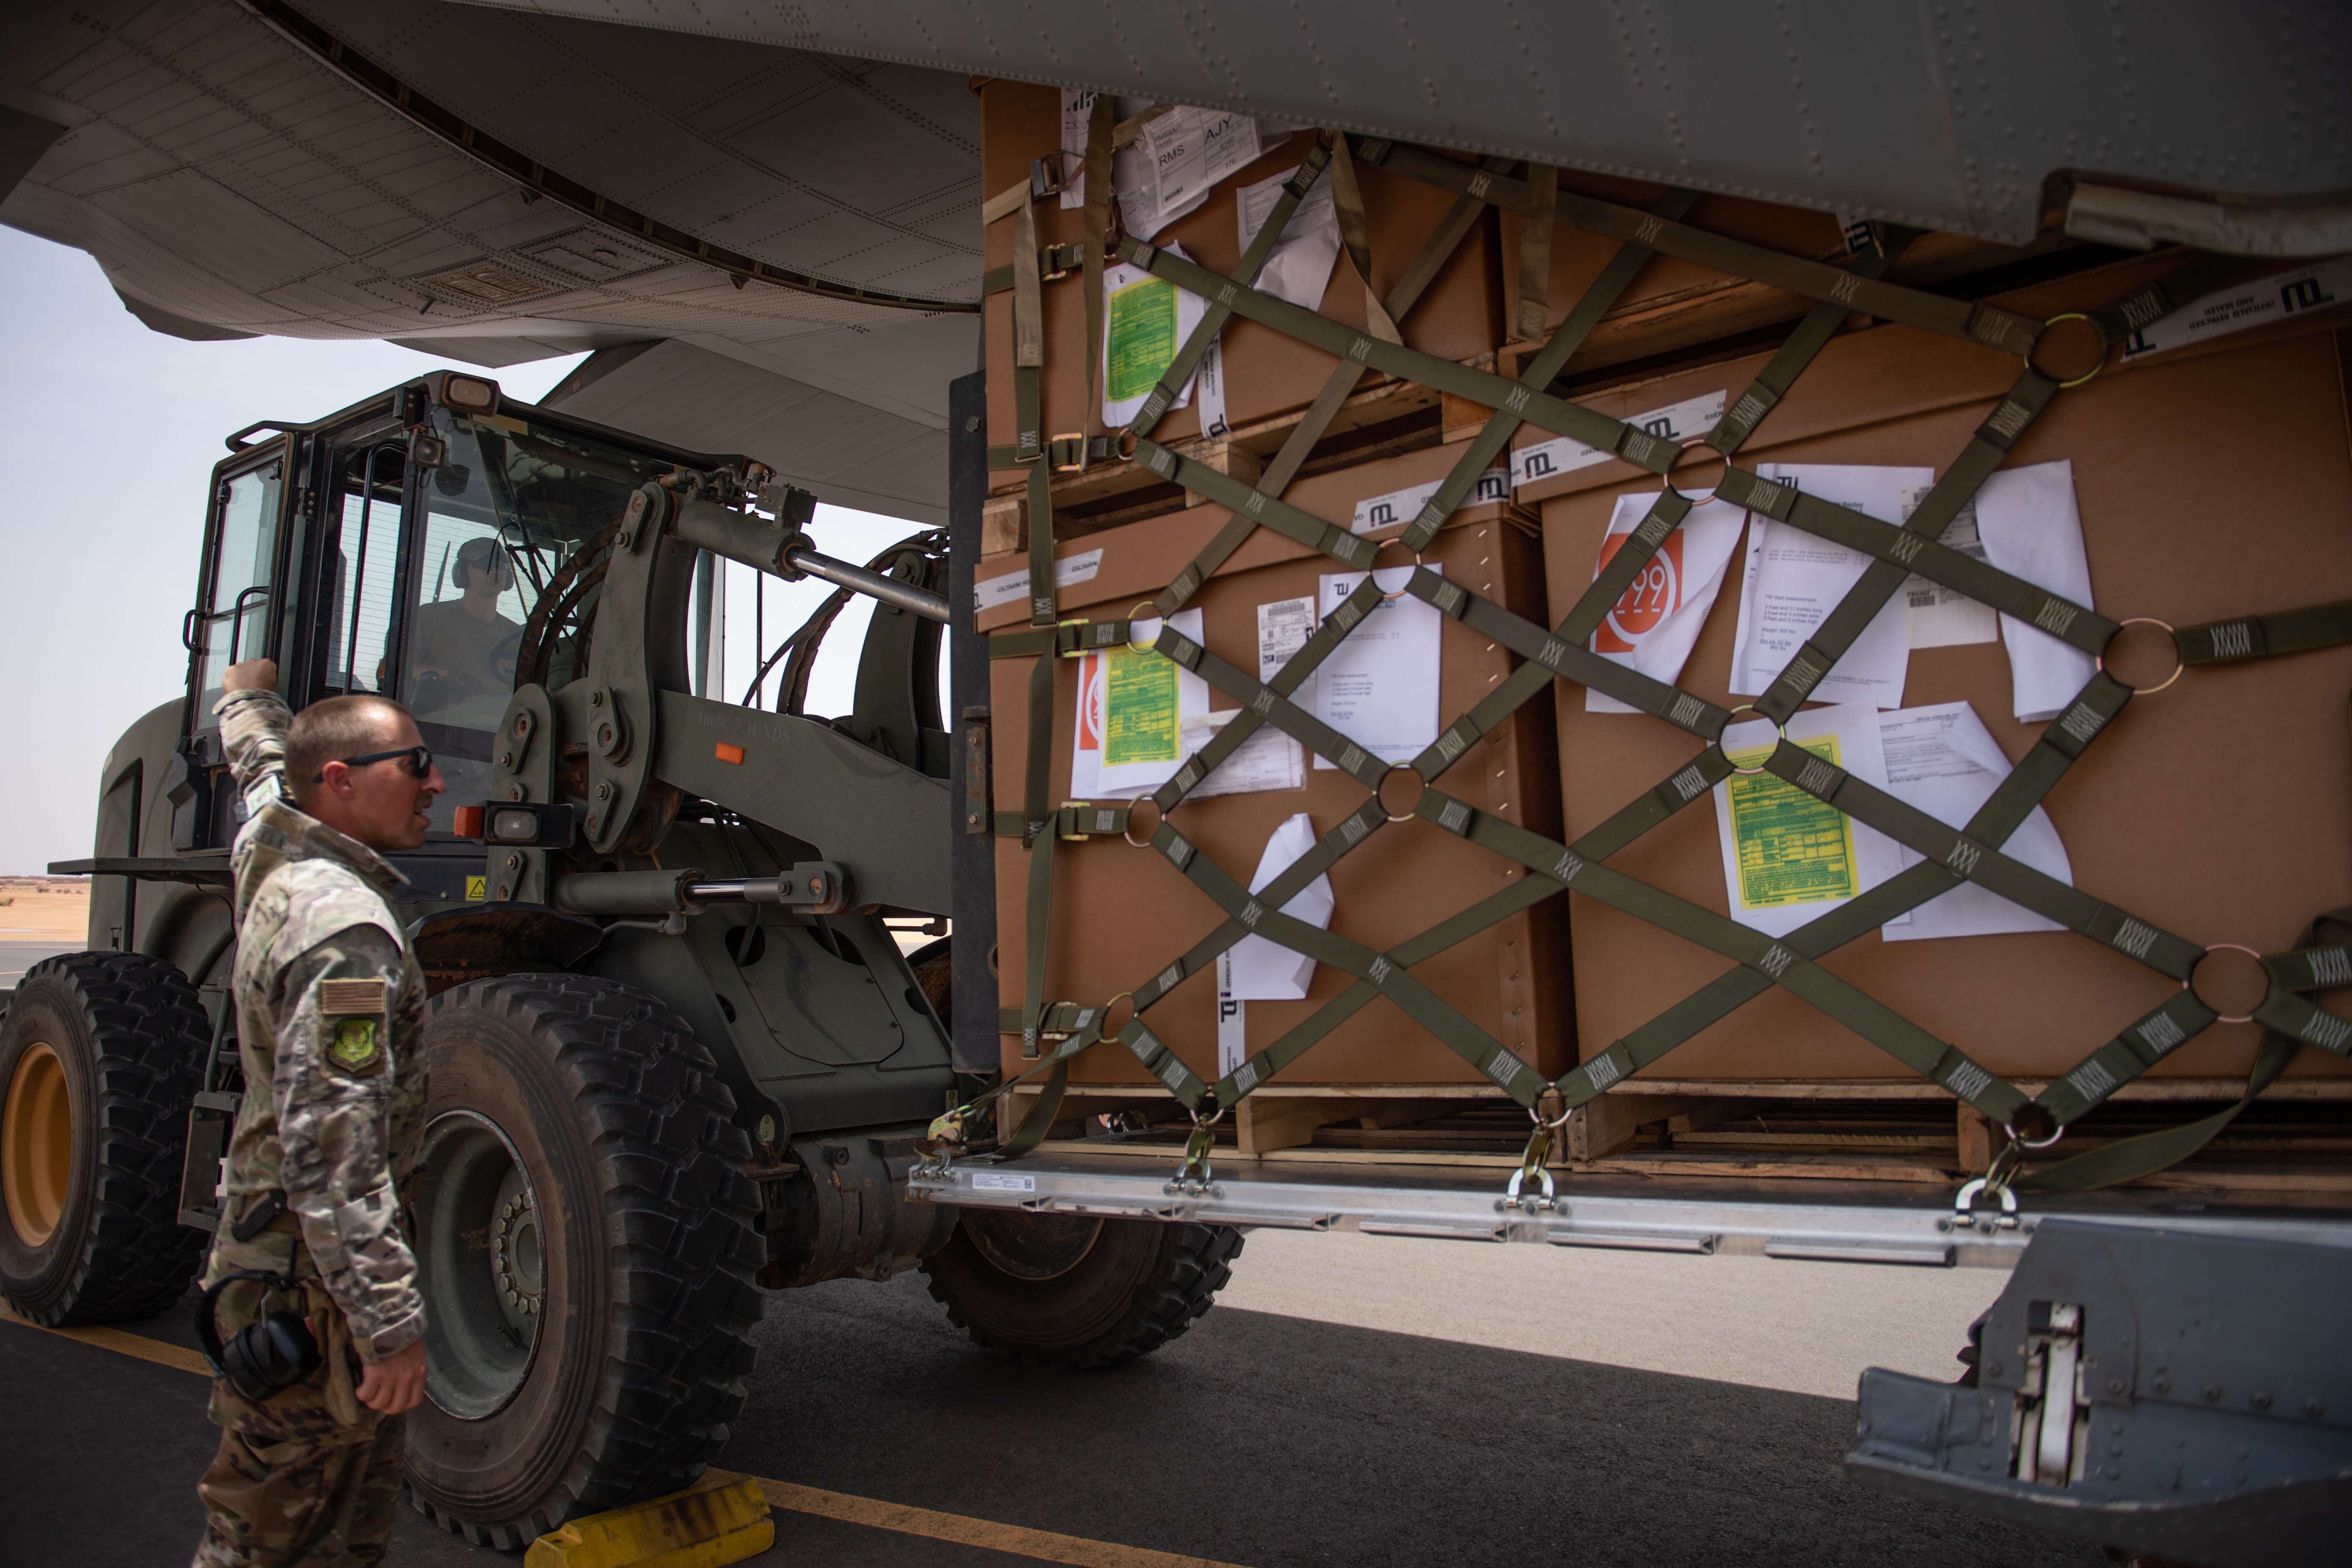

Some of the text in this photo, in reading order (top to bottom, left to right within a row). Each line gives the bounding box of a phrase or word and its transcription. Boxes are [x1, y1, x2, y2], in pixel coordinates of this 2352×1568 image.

[1154, 123, 1183, 144] RMS4XP/
[1205, 114, 1232, 144] AJY
[1220, 136, 1235, 149] 6160
[1159, 144, 1184, 167] RMS
[2189, 299, 2276, 330] OFFICIALLY REPACKED
[2204, 296, 2255, 316] AND SEALED
[1071, 560, 1098, 572] INSPECTED
[996, 581, 1021, 593] INSPECTED
[732, 719, 792, 743] POUNDS
